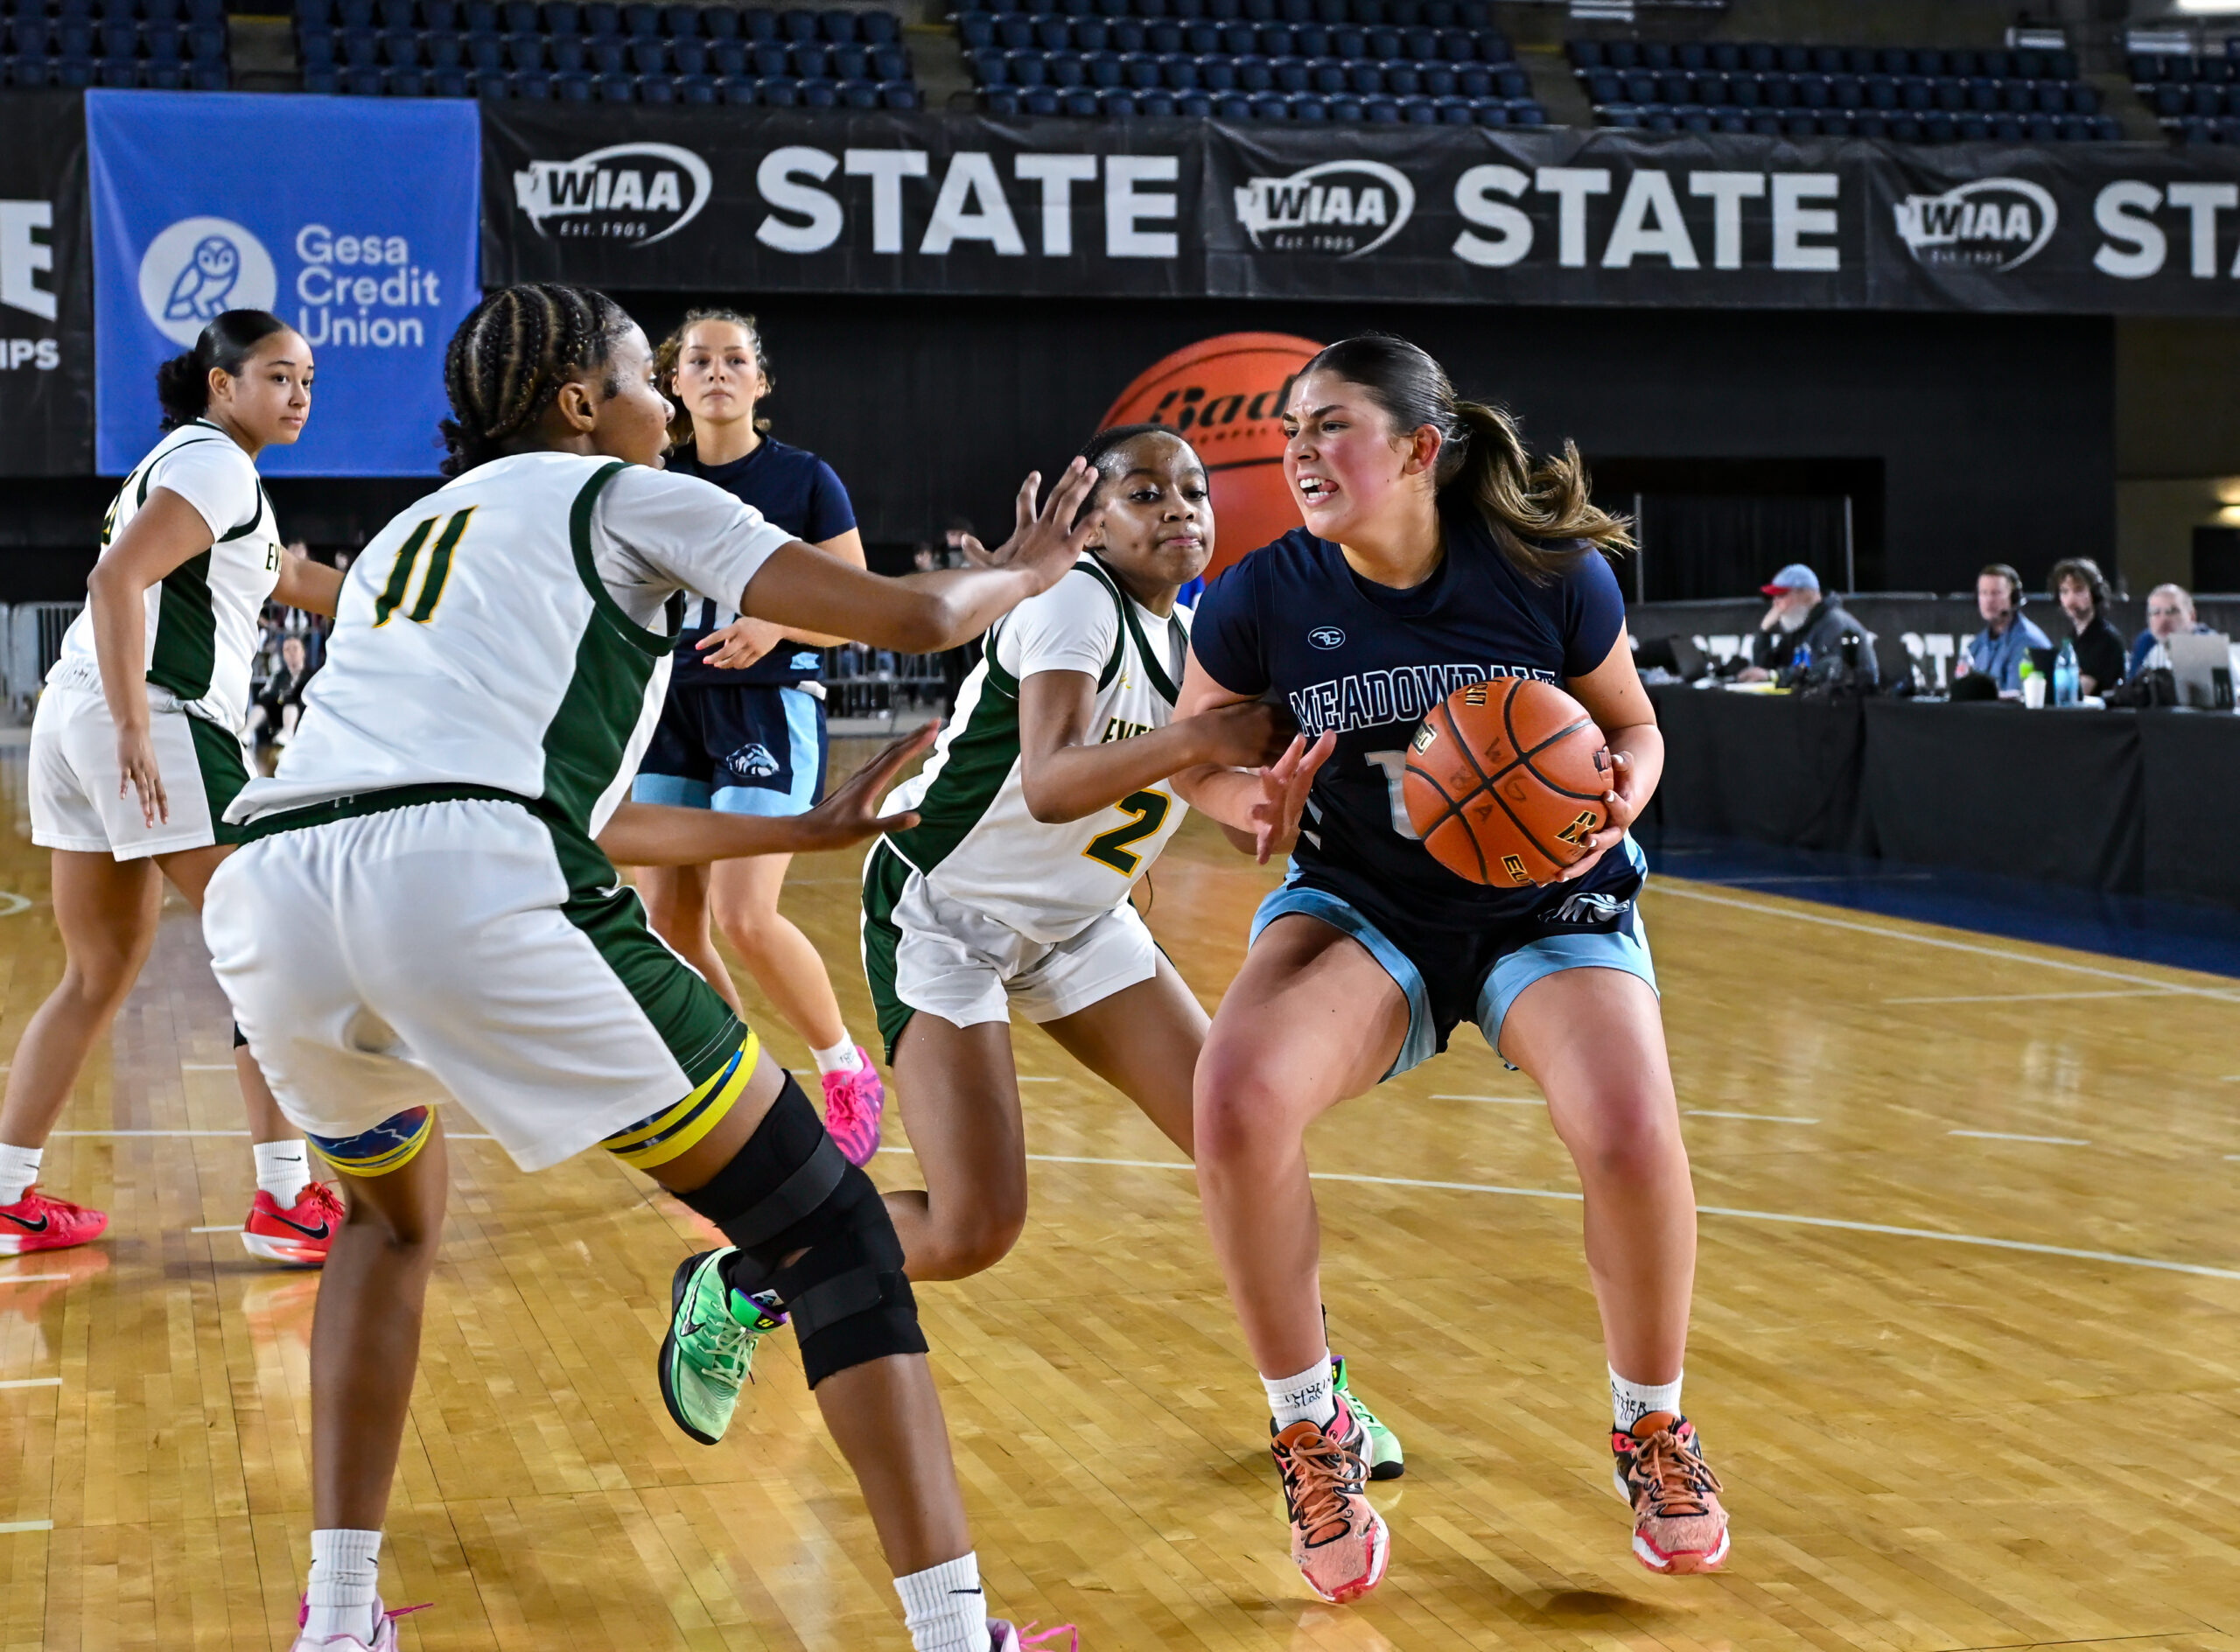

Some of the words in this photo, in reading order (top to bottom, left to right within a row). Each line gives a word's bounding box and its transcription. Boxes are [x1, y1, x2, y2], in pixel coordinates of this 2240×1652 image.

[548, 169, 682, 212] WIAA
[755, 145, 1180, 258] STATE
[1266, 186, 1388, 227] WIAA
[1452, 164, 1840, 271] STATE
[1922, 201, 2033, 242] WIAA
[2092, 178, 2240, 280] ST
[296, 224, 409, 265] Gesa
[296, 266, 441, 305] Credit
[298, 306, 424, 347] Union
[373, 505, 478, 628] 11
[1082, 788, 1172, 878] 2
